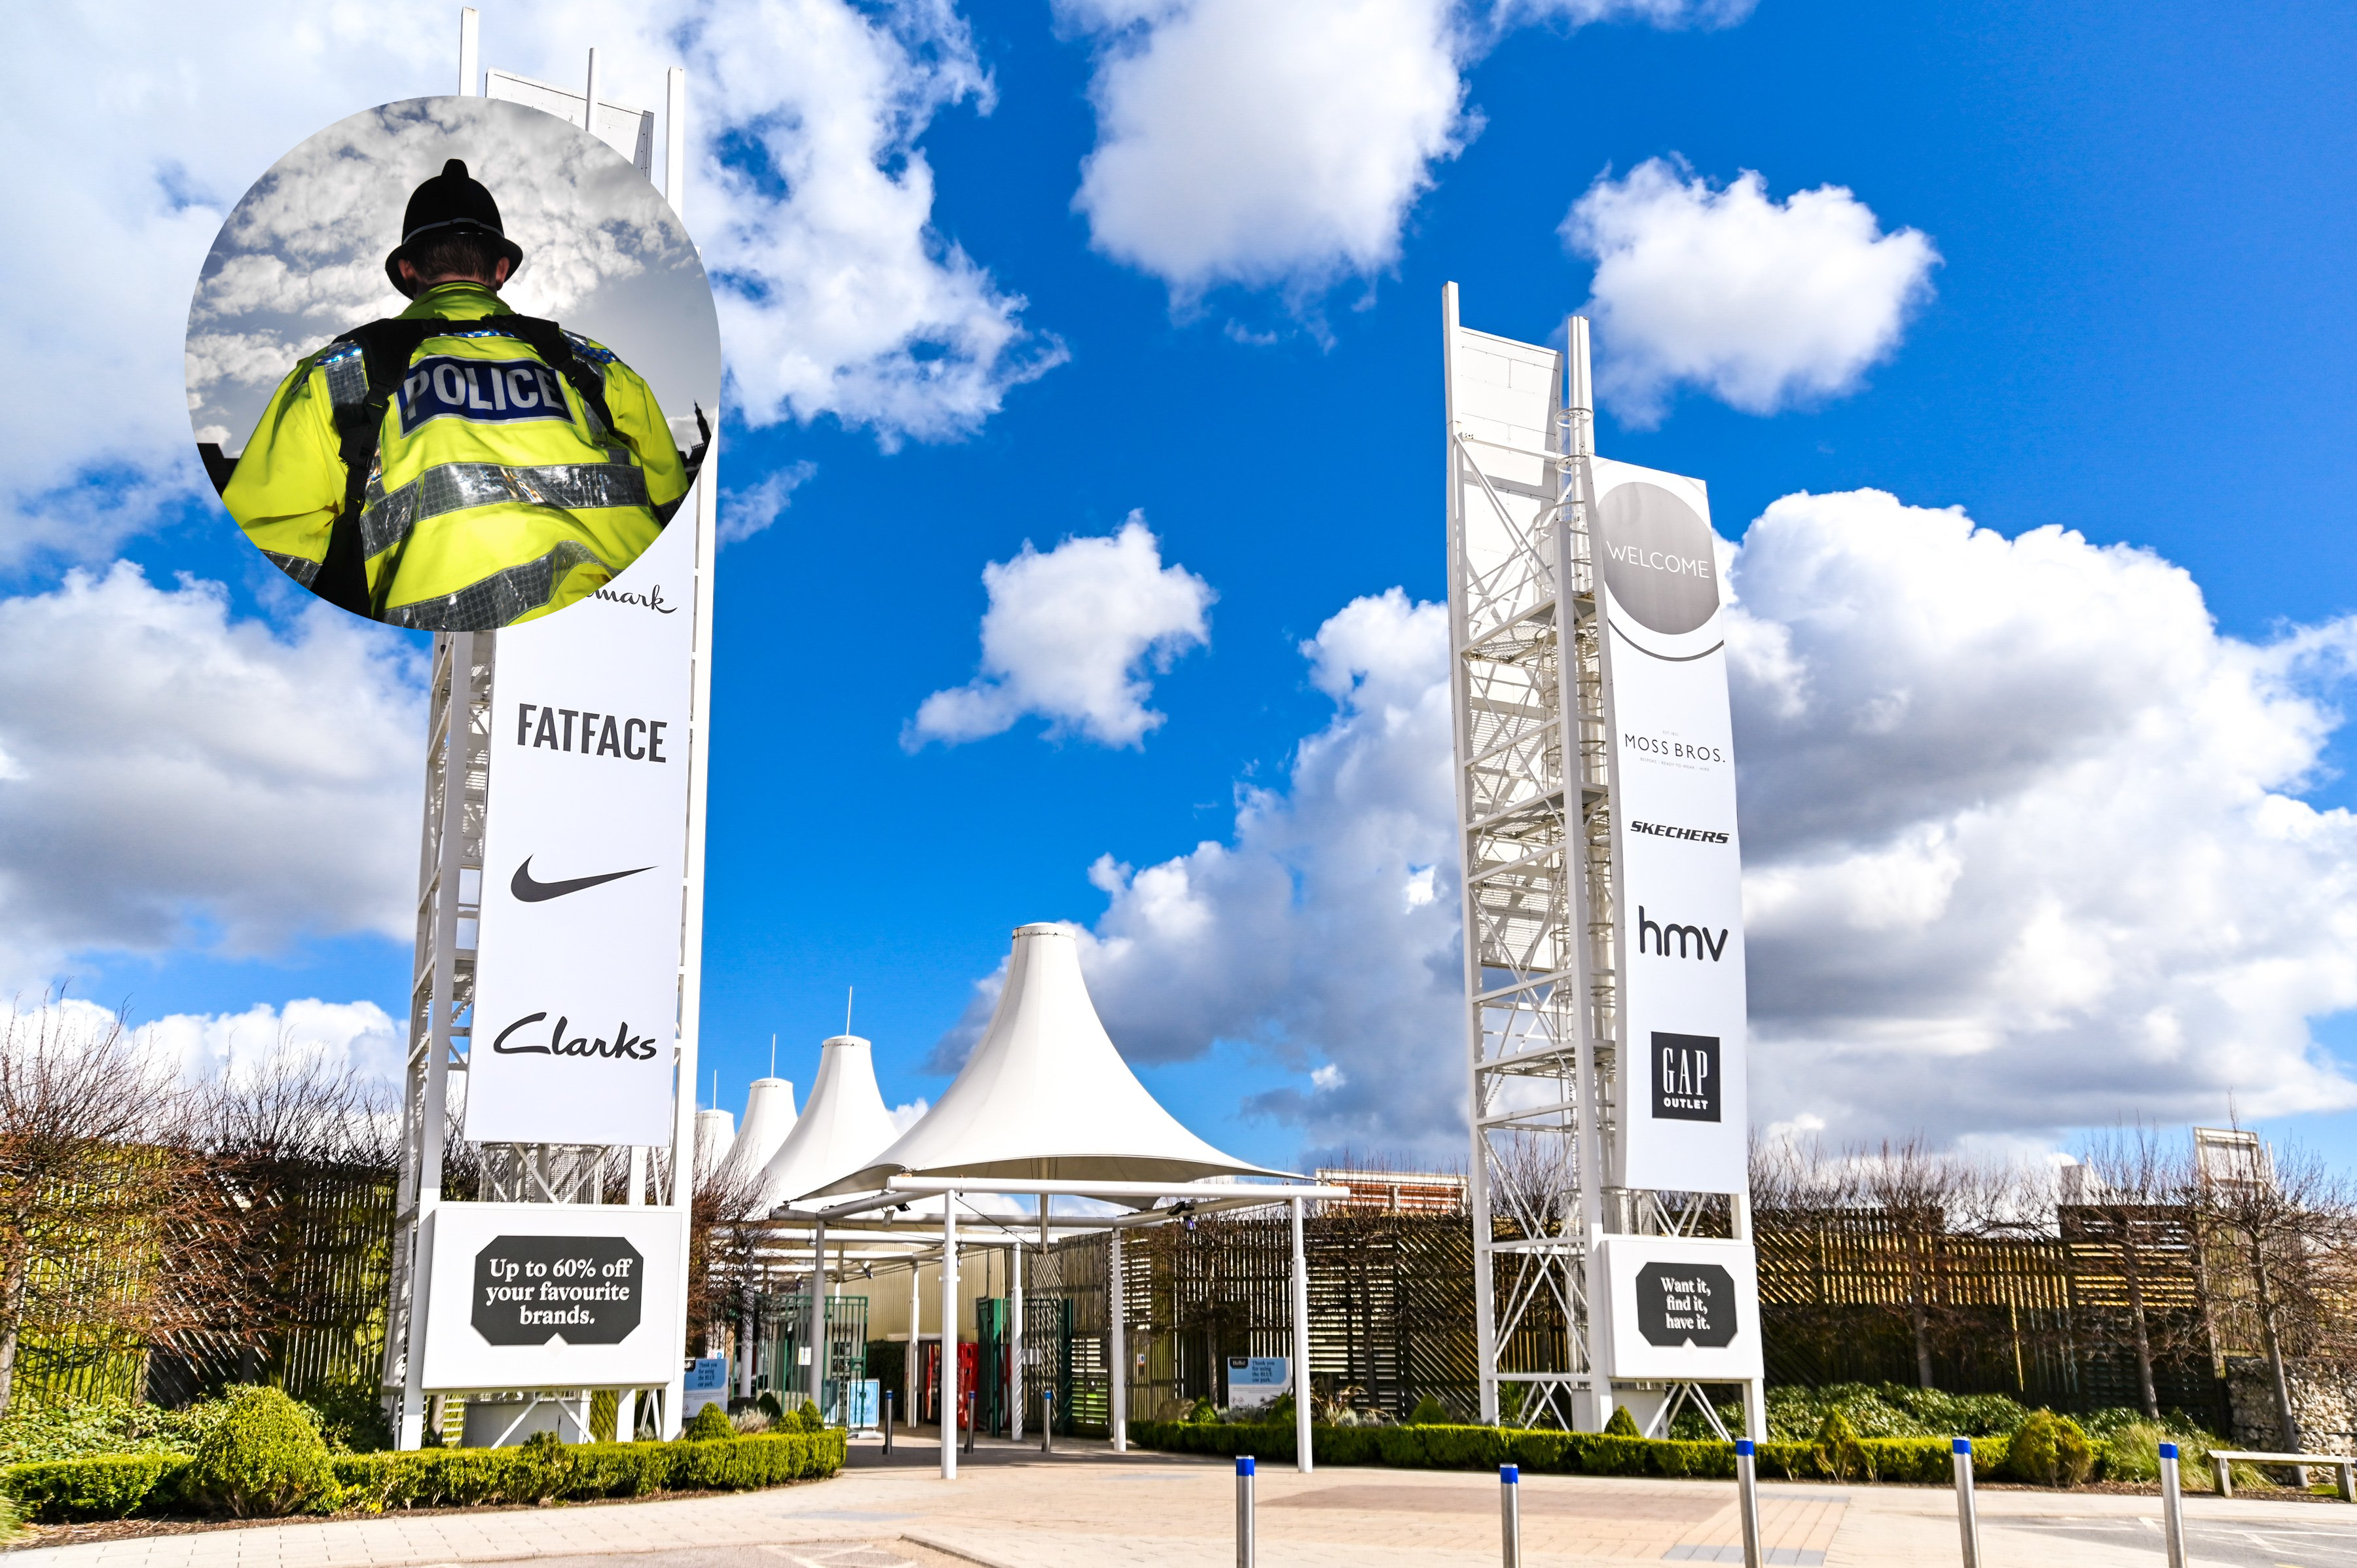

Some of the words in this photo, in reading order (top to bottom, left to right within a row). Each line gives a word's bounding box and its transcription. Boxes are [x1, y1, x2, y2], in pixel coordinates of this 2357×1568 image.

[403, 363, 564, 421] POLICE
[1606, 541, 1710, 579] WELCOME
[517, 703, 667, 763] FATFACE
[1624, 733, 1669, 755] MOSS
[1675, 743, 1726, 763] BROS.
[1630, 820, 1730, 844] SKECHERS
[1638, 905, 1728, 962] hmv
[492, 1012, 657, 1061] Clarks
[1662, 1047, 1708, 1096] GAP
[1663, 1097, 1708, 1110] OUTLET
[489, 1258, 520, 1283] Up
[524, 1260, 548, 1277] to
[553, 1258, 597, 1279] 60%
[602, 1258, 634, 1277] off
[485, 1286, 535, 1306] your
[539, 1281, 630, 1301] favourite
[1660, 1277, 1695, 1293] Want
[1696, 1277, 1711, 1296] it,
[519, 1304, 596, 1324] brands.
[1666, 1294, 1691, 1311] find
[1693, 1295, 1708, 1315] it,
[1665, 1313, 1694, 1330] have
[1696, 1313, 1711, 1330] it.
